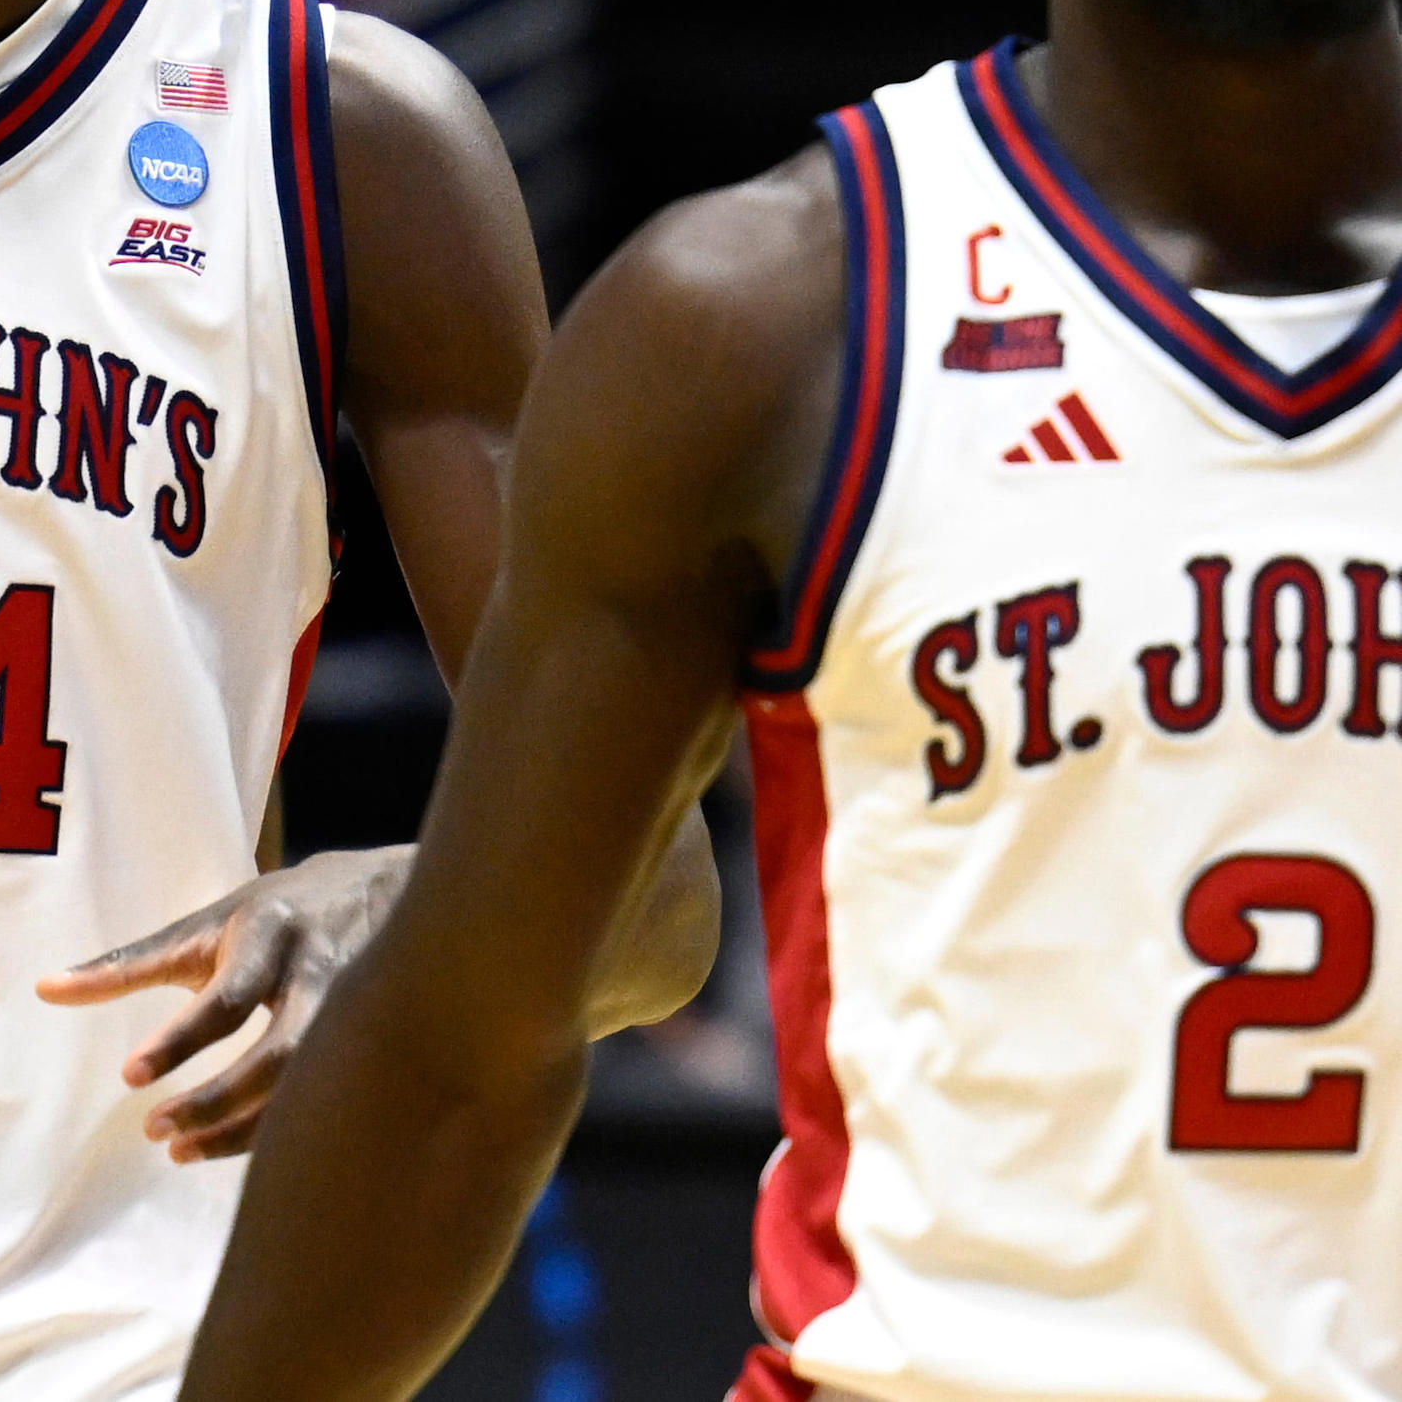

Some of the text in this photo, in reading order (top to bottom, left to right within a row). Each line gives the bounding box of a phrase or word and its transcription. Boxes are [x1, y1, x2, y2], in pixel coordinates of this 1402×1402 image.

[141, 156, 204, 188] NCAA
[115, 238, 206, 268] EAST
[126, 217, 192, 244] BIG
[968, 225, 1012, 305] C
[910, 579, 1103, 802] ST.
[1167, 851, 1377, 1153] 2
